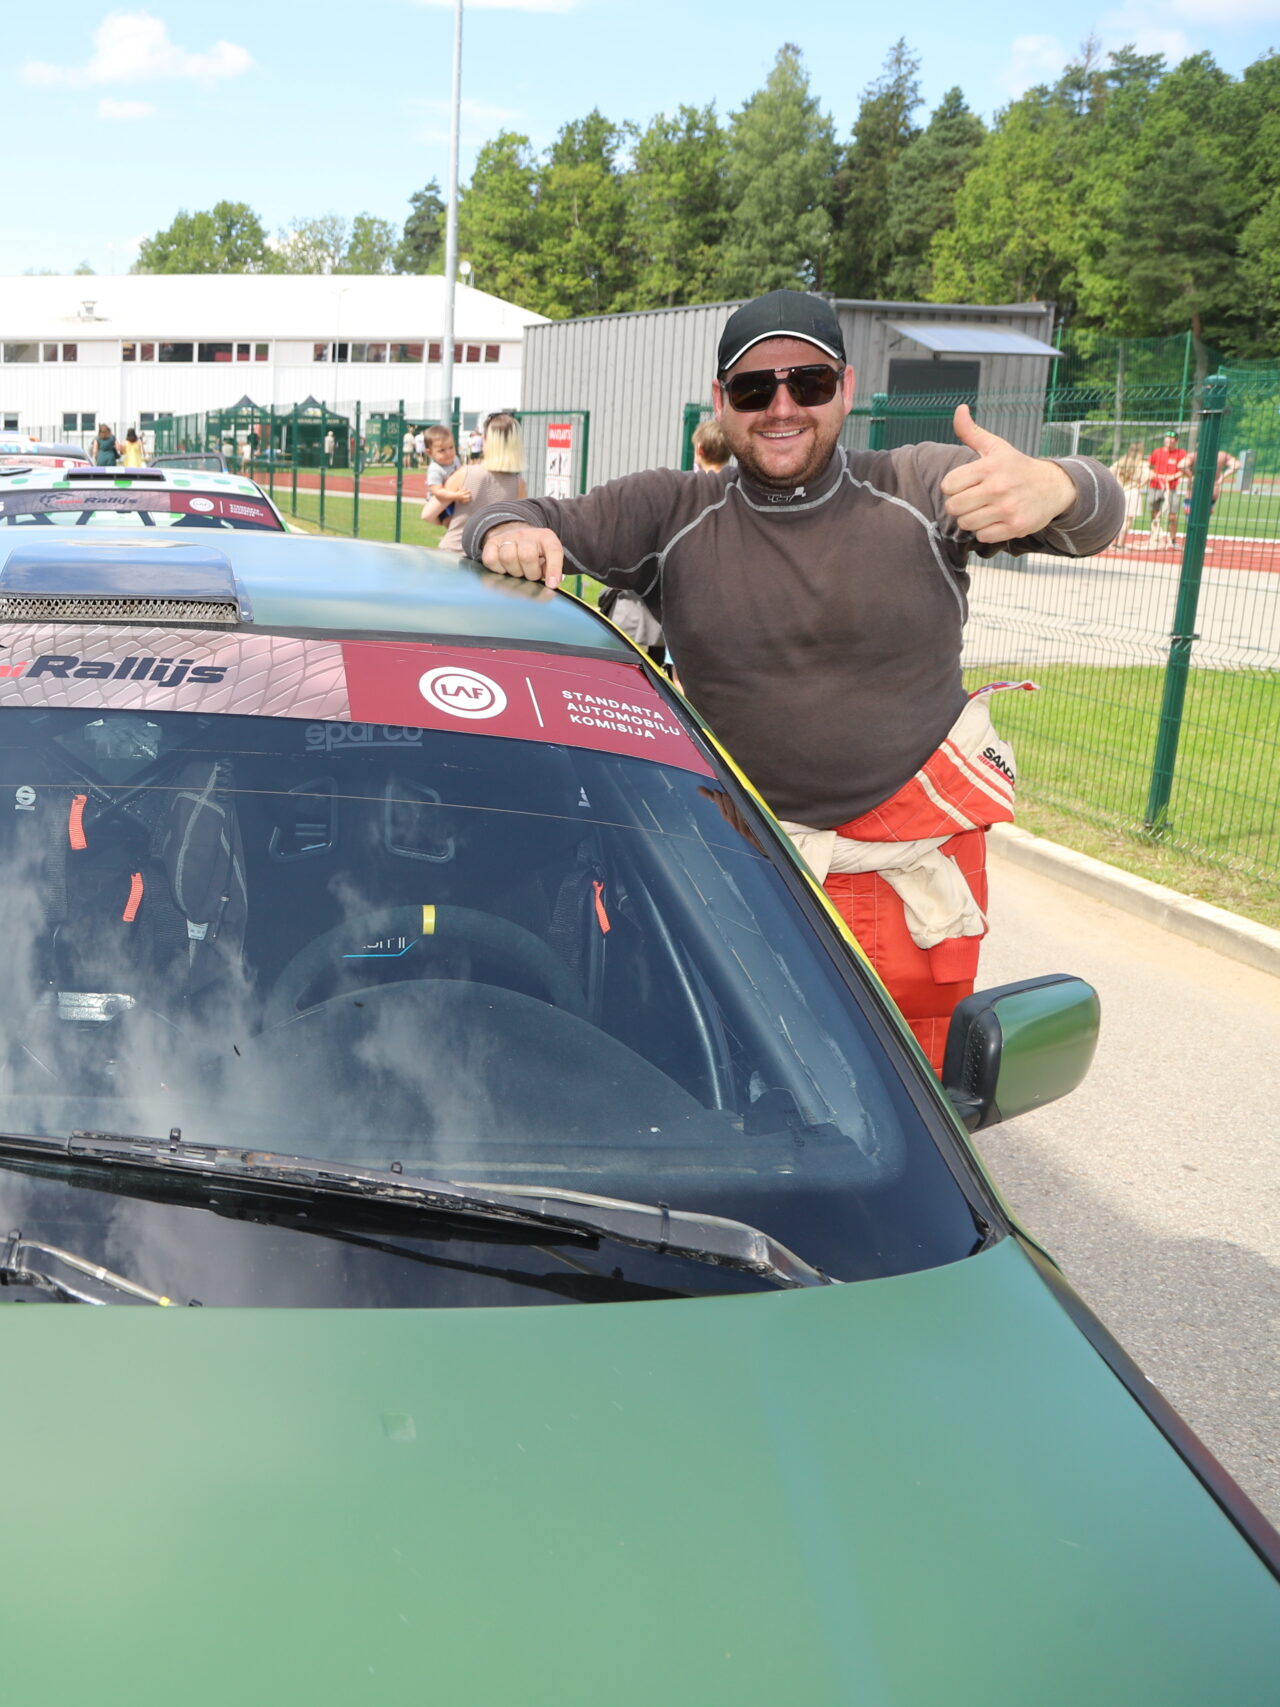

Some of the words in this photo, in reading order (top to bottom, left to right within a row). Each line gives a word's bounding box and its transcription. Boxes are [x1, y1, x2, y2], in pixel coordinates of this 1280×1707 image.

[439, 683, 485, 701] LAF
[561, 690, 665, 721] STANDARTA
[567, 702, 681, 736] AUTOMOBIĻU
[569, 714, 656, 740] KOMISIJA
